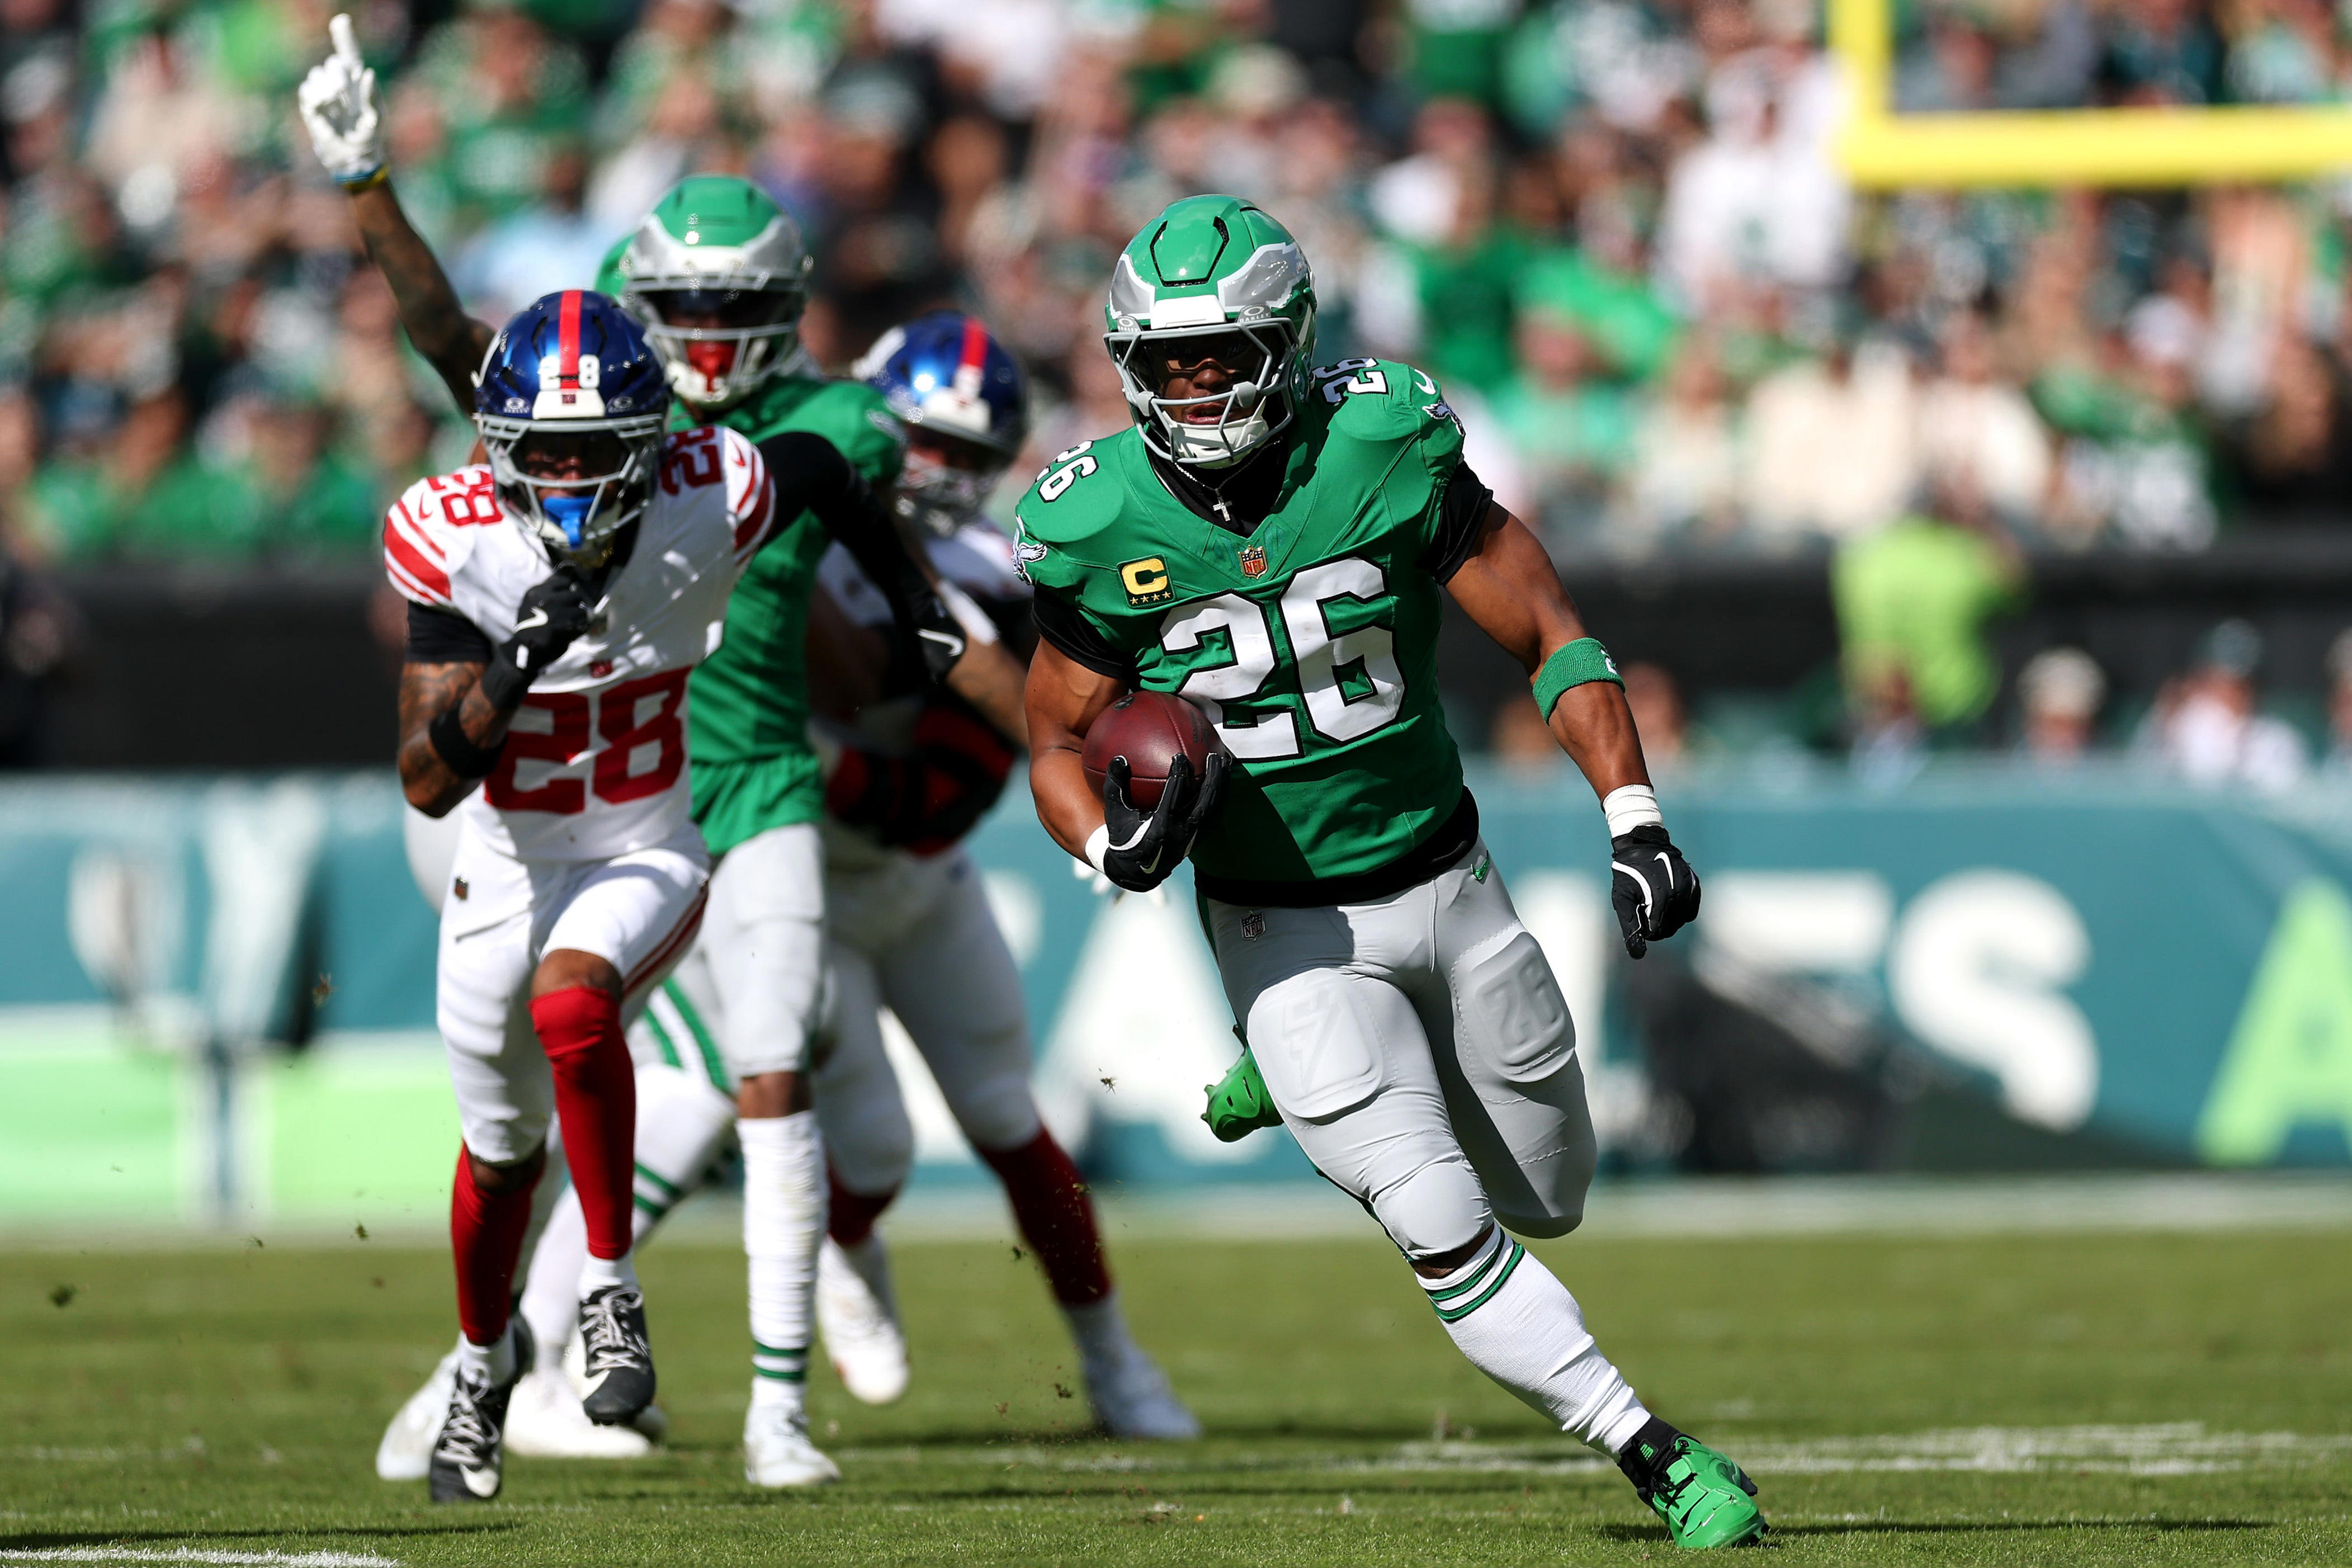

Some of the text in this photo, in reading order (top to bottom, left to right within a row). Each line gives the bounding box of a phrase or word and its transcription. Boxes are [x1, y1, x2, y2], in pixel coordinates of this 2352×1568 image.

[1312, 357, 1389, 404] 26
[1121, 558, 1168, 595] C
[1244, 559, 1264, 574] NFL
[1159, 555, 1408, 763] 26
[484, 664, 695, 815] 28
[1244, 922, 1263, 937] NFL
